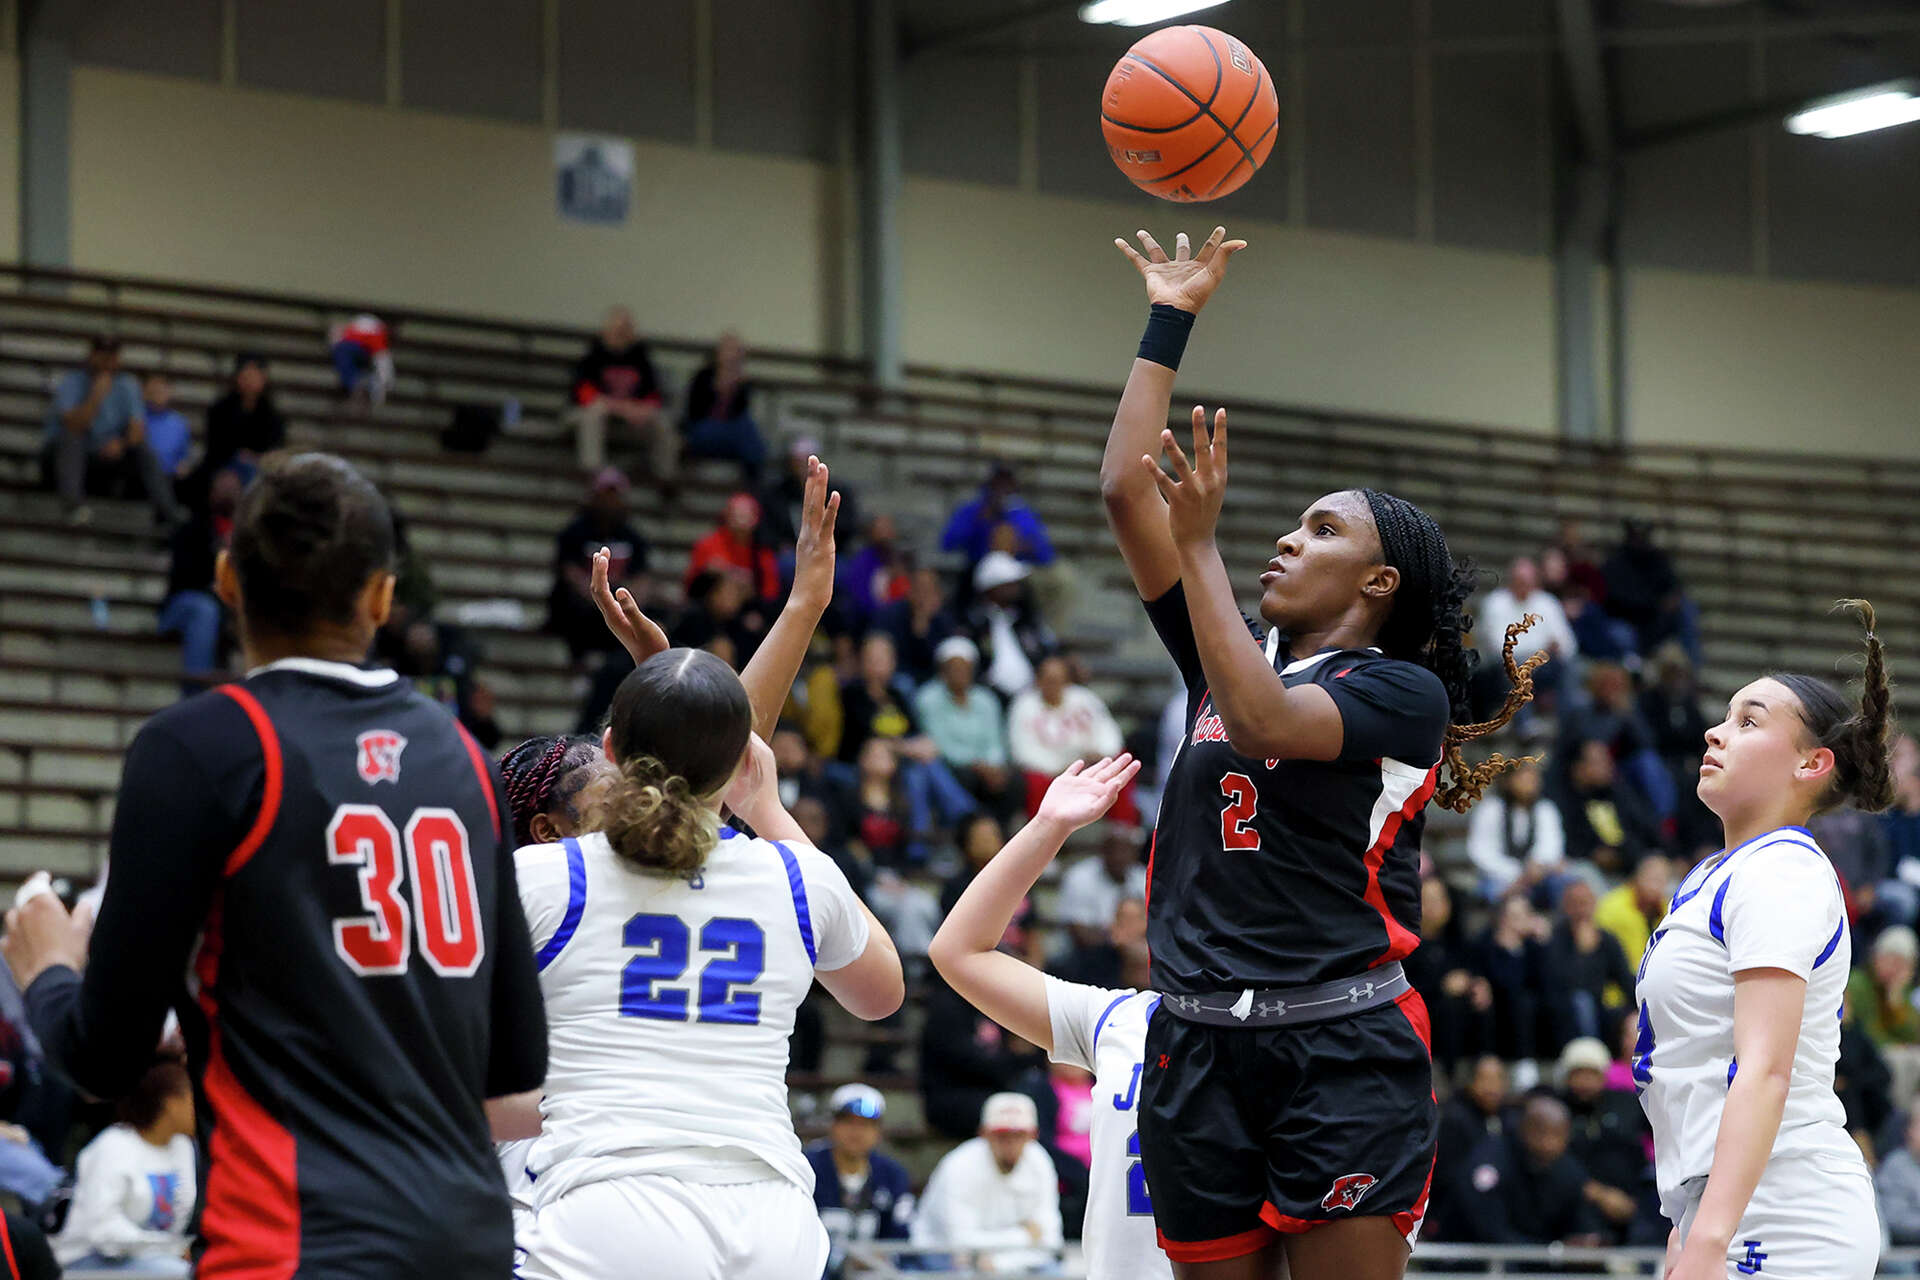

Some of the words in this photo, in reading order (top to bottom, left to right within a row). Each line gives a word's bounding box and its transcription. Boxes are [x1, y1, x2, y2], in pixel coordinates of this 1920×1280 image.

[1219, 771, 1261, 852] 2
[325, 803, 485, 978] 30
[618, 912, 766, 1025] 22
[1113, 1062, 1144, 1112] J
